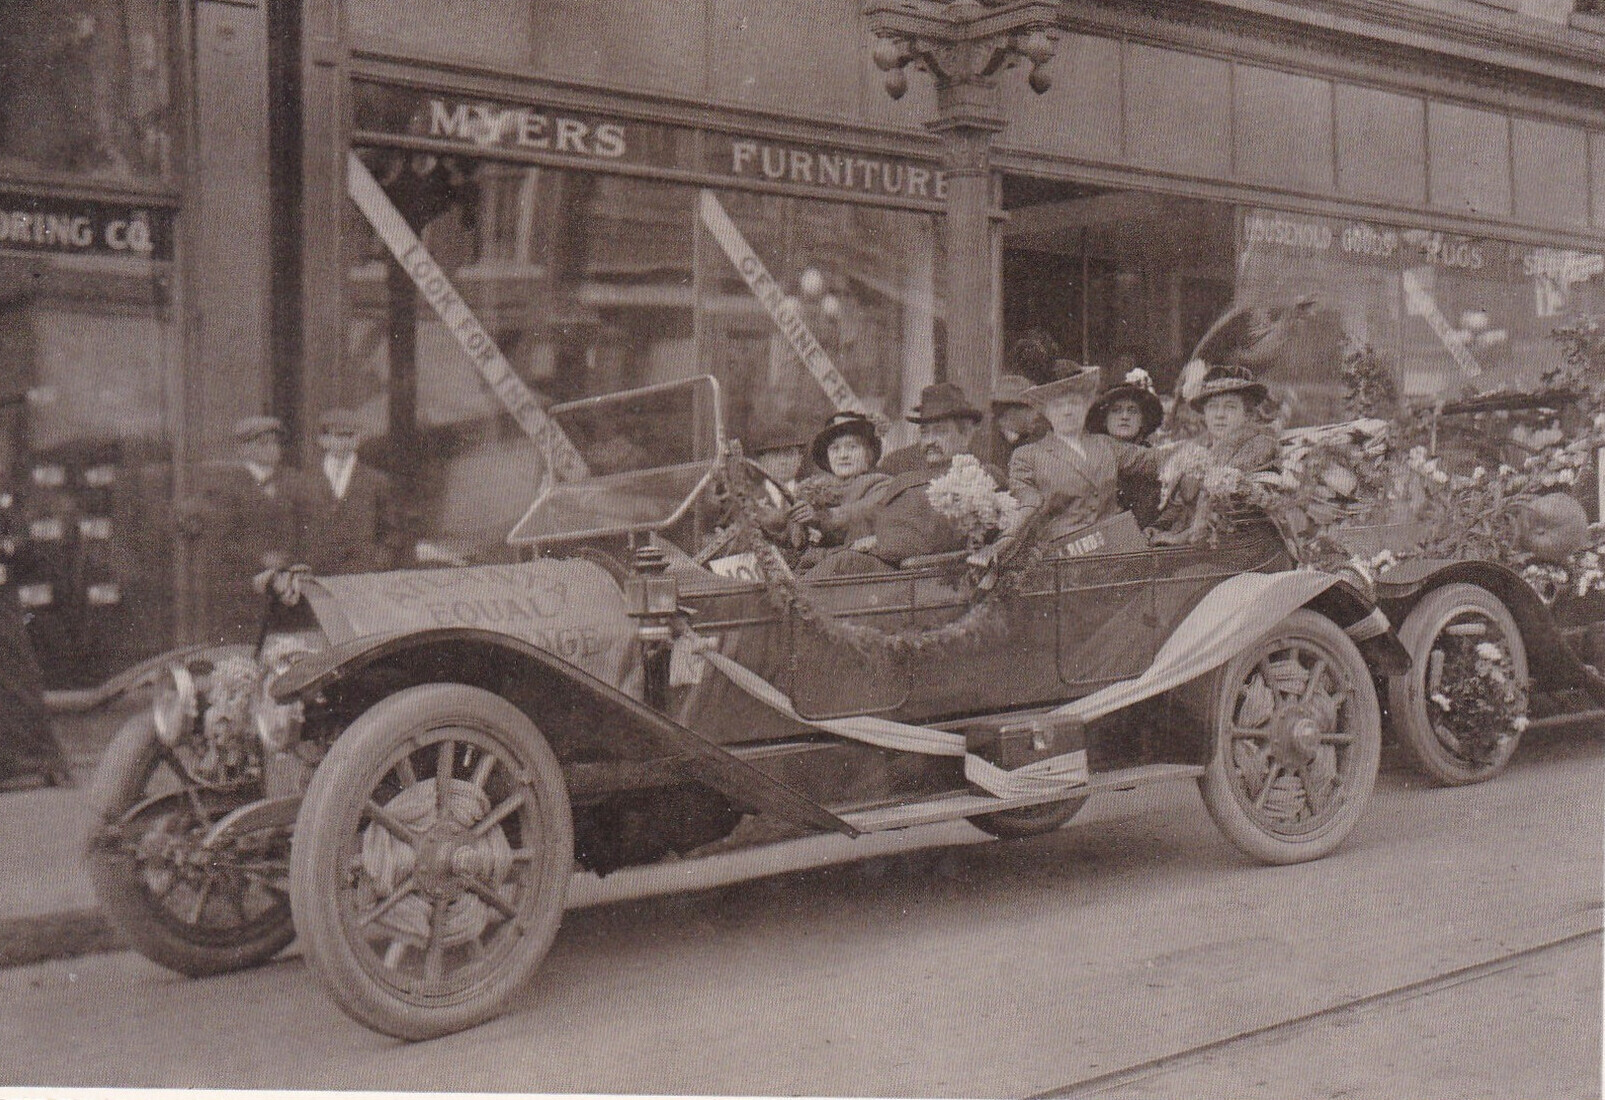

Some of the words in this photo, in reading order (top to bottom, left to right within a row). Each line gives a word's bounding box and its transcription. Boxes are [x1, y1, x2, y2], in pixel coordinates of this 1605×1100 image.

[430, 99, 627, 158] MYERS
[398, 243, 460, 315] LOOK
[453, 316, 499, 367] FOR
[425, 597, 559, 625] EQUAL
